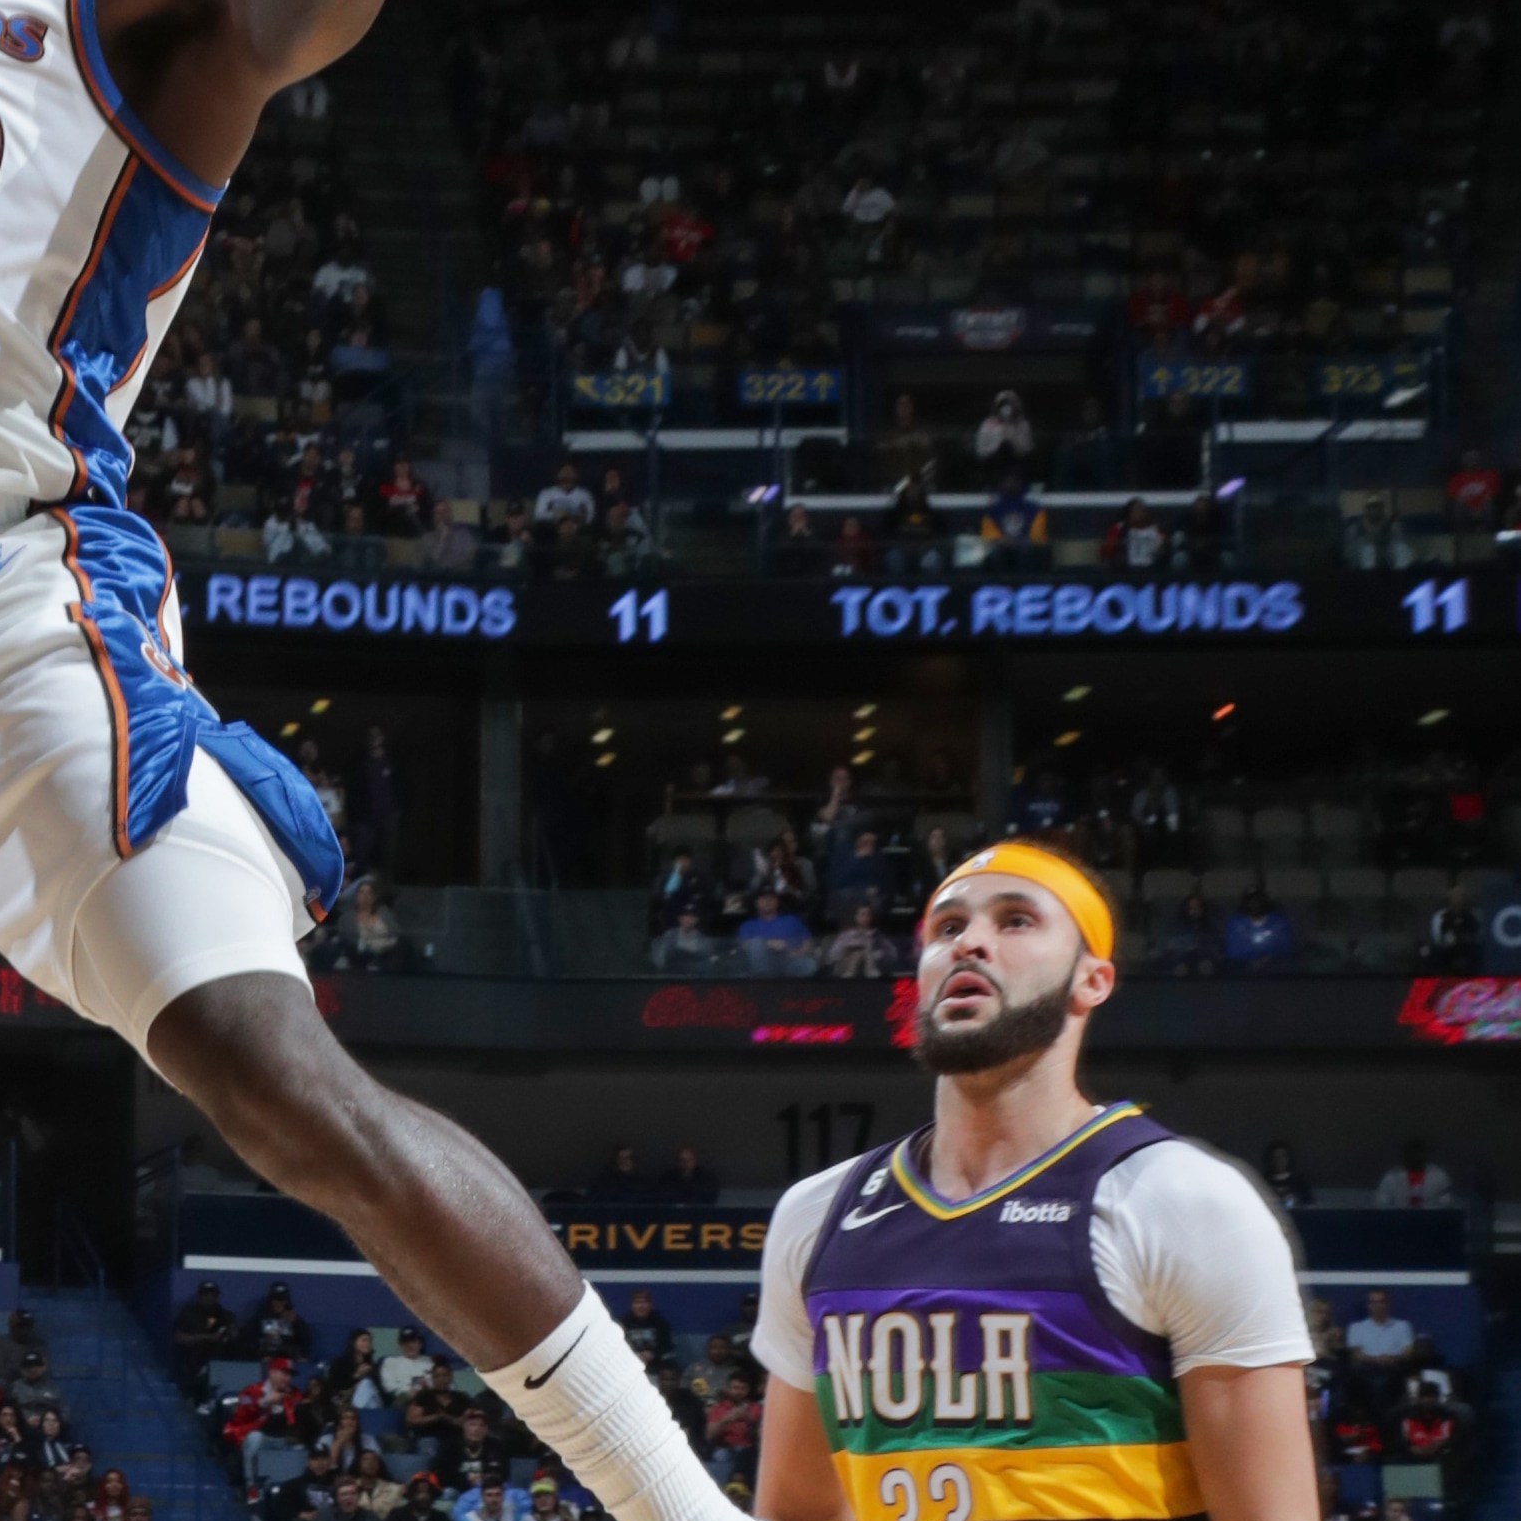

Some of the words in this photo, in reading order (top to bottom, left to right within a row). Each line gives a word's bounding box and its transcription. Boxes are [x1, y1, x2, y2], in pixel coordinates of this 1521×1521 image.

[603, 373, 663, 404] 321
[744, 373, 806, 401] 322
[1180, 365, 1243, 395] 322
[207, 573, 517, 638] REBOUNDS
[609, 587, 669, 643] 11
[830, 583, 956, 637] TOT.
[970, 581, 1305, 635] REBOUNDS
[1401, 579, 1469, 634] 11
[777, 1101, 876, 1179] 117
[860, 1167, 889, 1196] 6
[999, 1200, 1073, 1223] ibotta
[562, 1222, 770, 1251] RIVERS
[823, 1311, 1033, 1428] NOLA
